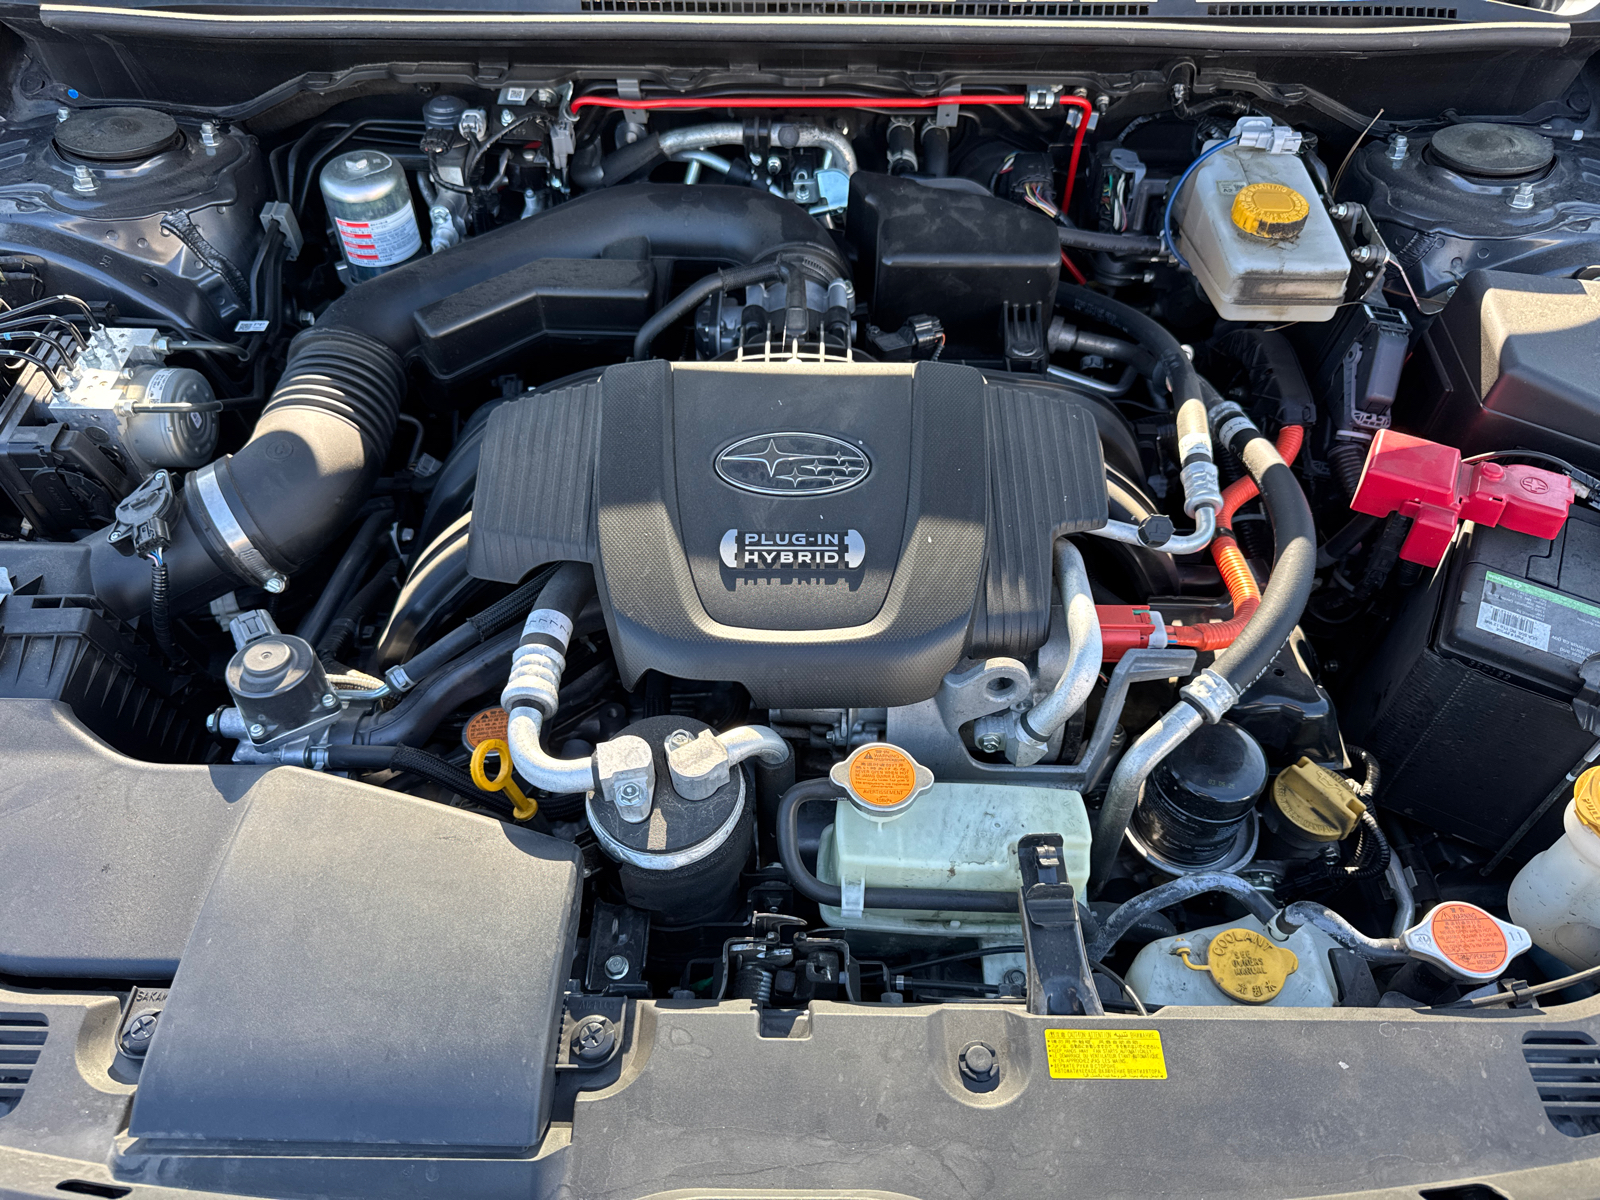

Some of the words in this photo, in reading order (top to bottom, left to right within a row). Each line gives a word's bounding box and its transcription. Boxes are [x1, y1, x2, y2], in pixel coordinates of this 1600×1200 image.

[745, 533, 839, 545] PLUG-IN
[744, 551, 839, 563] HYBRID
[1213, 932, 1273, 956] COOLANT
[1234, 950, 1252, 959] SEE
[1234, 967, 1267, 976] MANUAL
